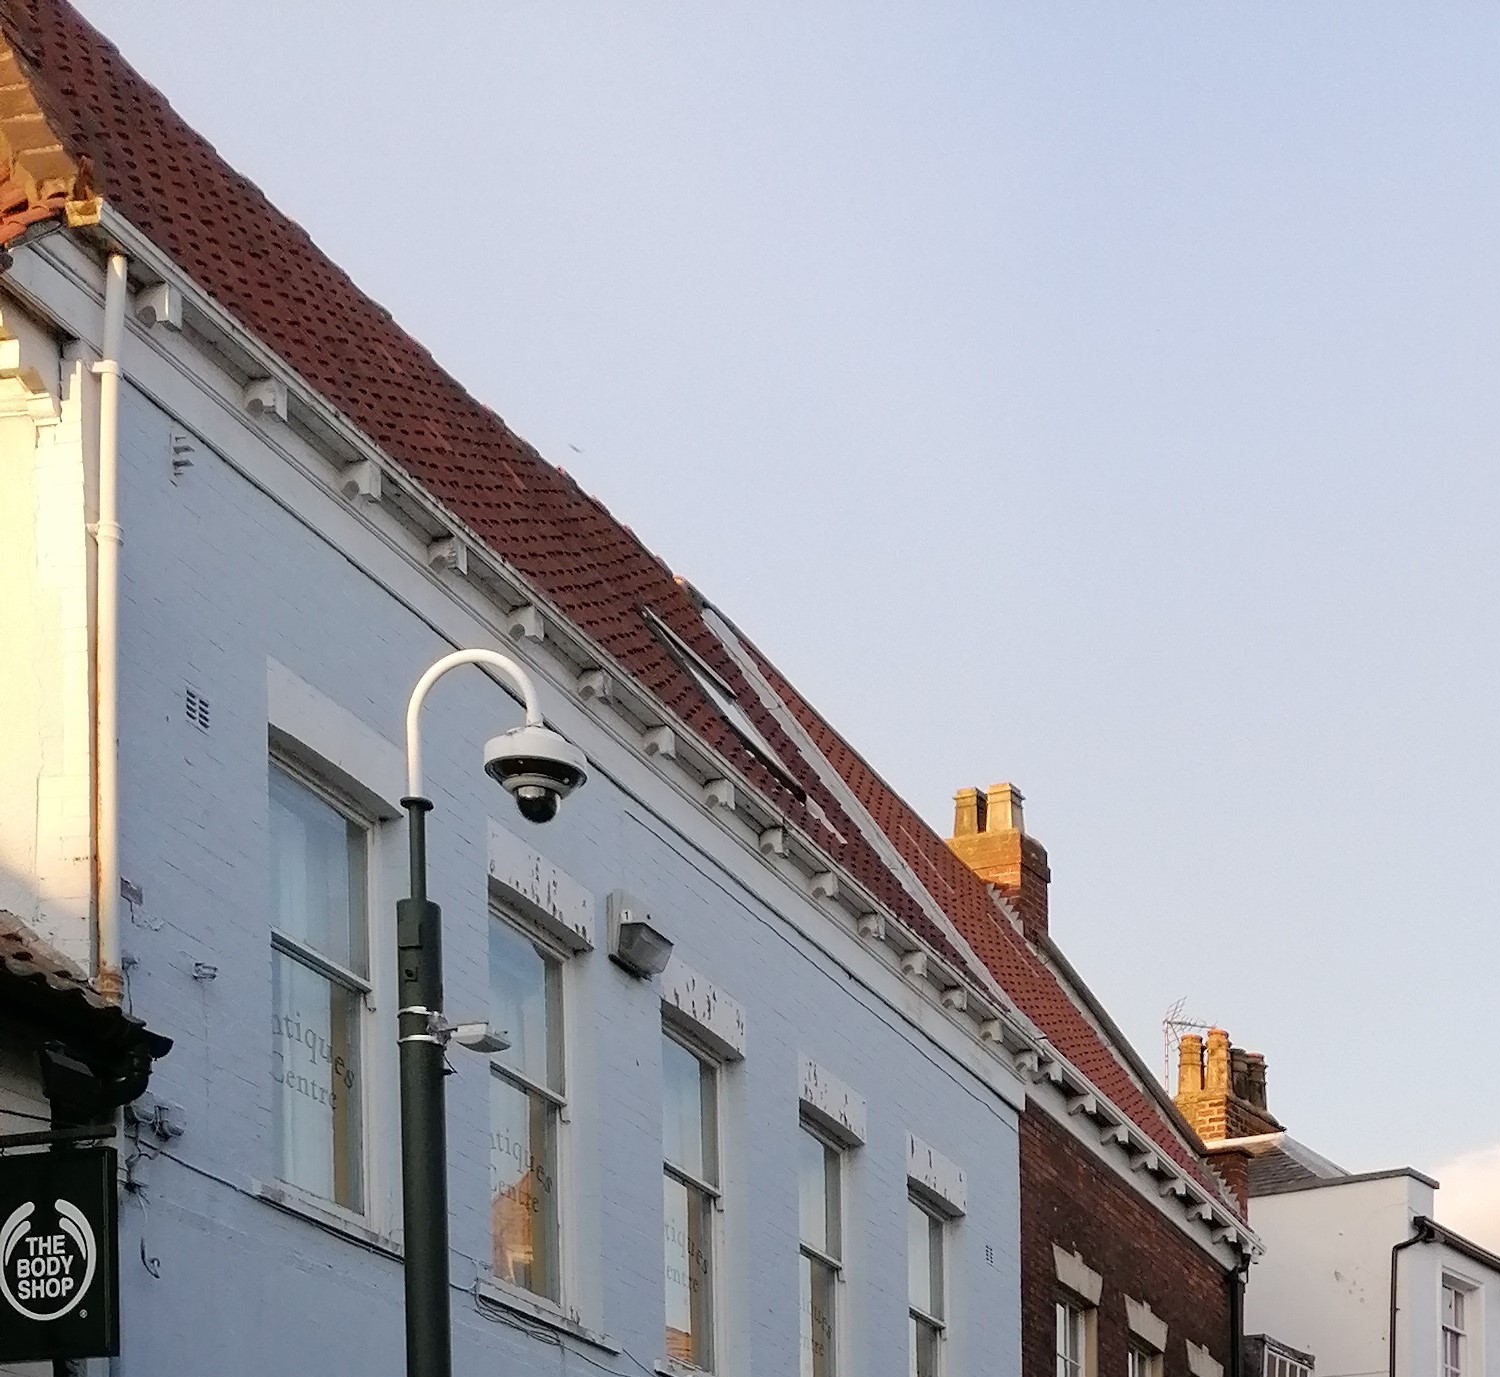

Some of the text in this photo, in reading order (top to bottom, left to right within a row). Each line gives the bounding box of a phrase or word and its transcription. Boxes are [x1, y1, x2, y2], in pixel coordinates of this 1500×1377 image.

[25, 1234, 66, 1256] THE
[16, 1255, 74, 1279] BODY
[17, 1277, 74, 1300] SHOP
